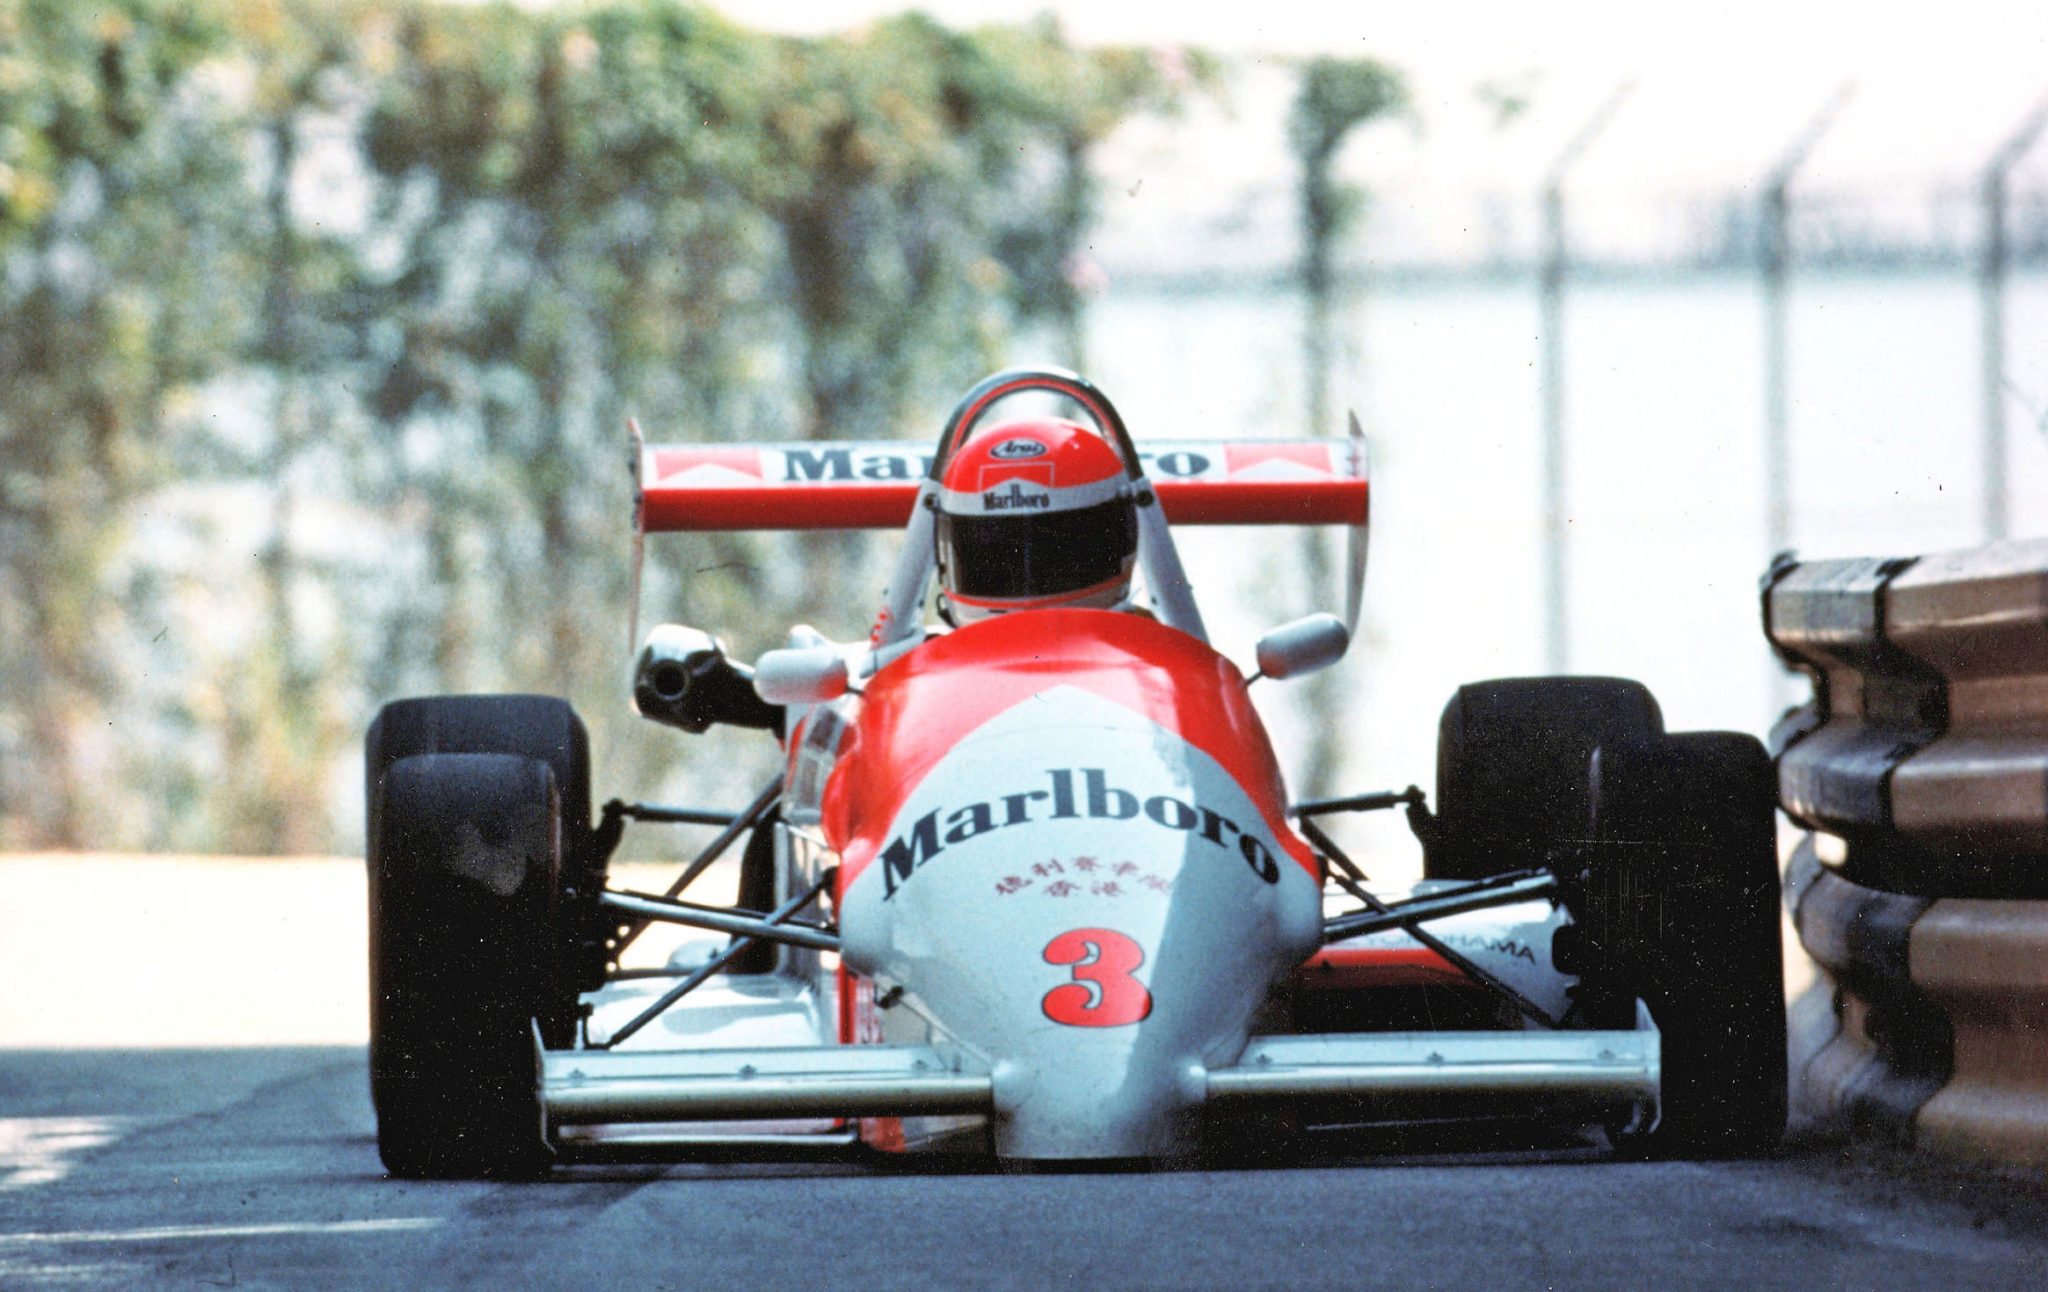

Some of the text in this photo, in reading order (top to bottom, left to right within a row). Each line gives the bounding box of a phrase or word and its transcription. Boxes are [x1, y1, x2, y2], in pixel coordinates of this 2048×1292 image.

[983, 483, 1050, 511] Marlboro
[879, 768, 1281, 901] Marlboro
[1041, 927, 1153, 1029] 3
